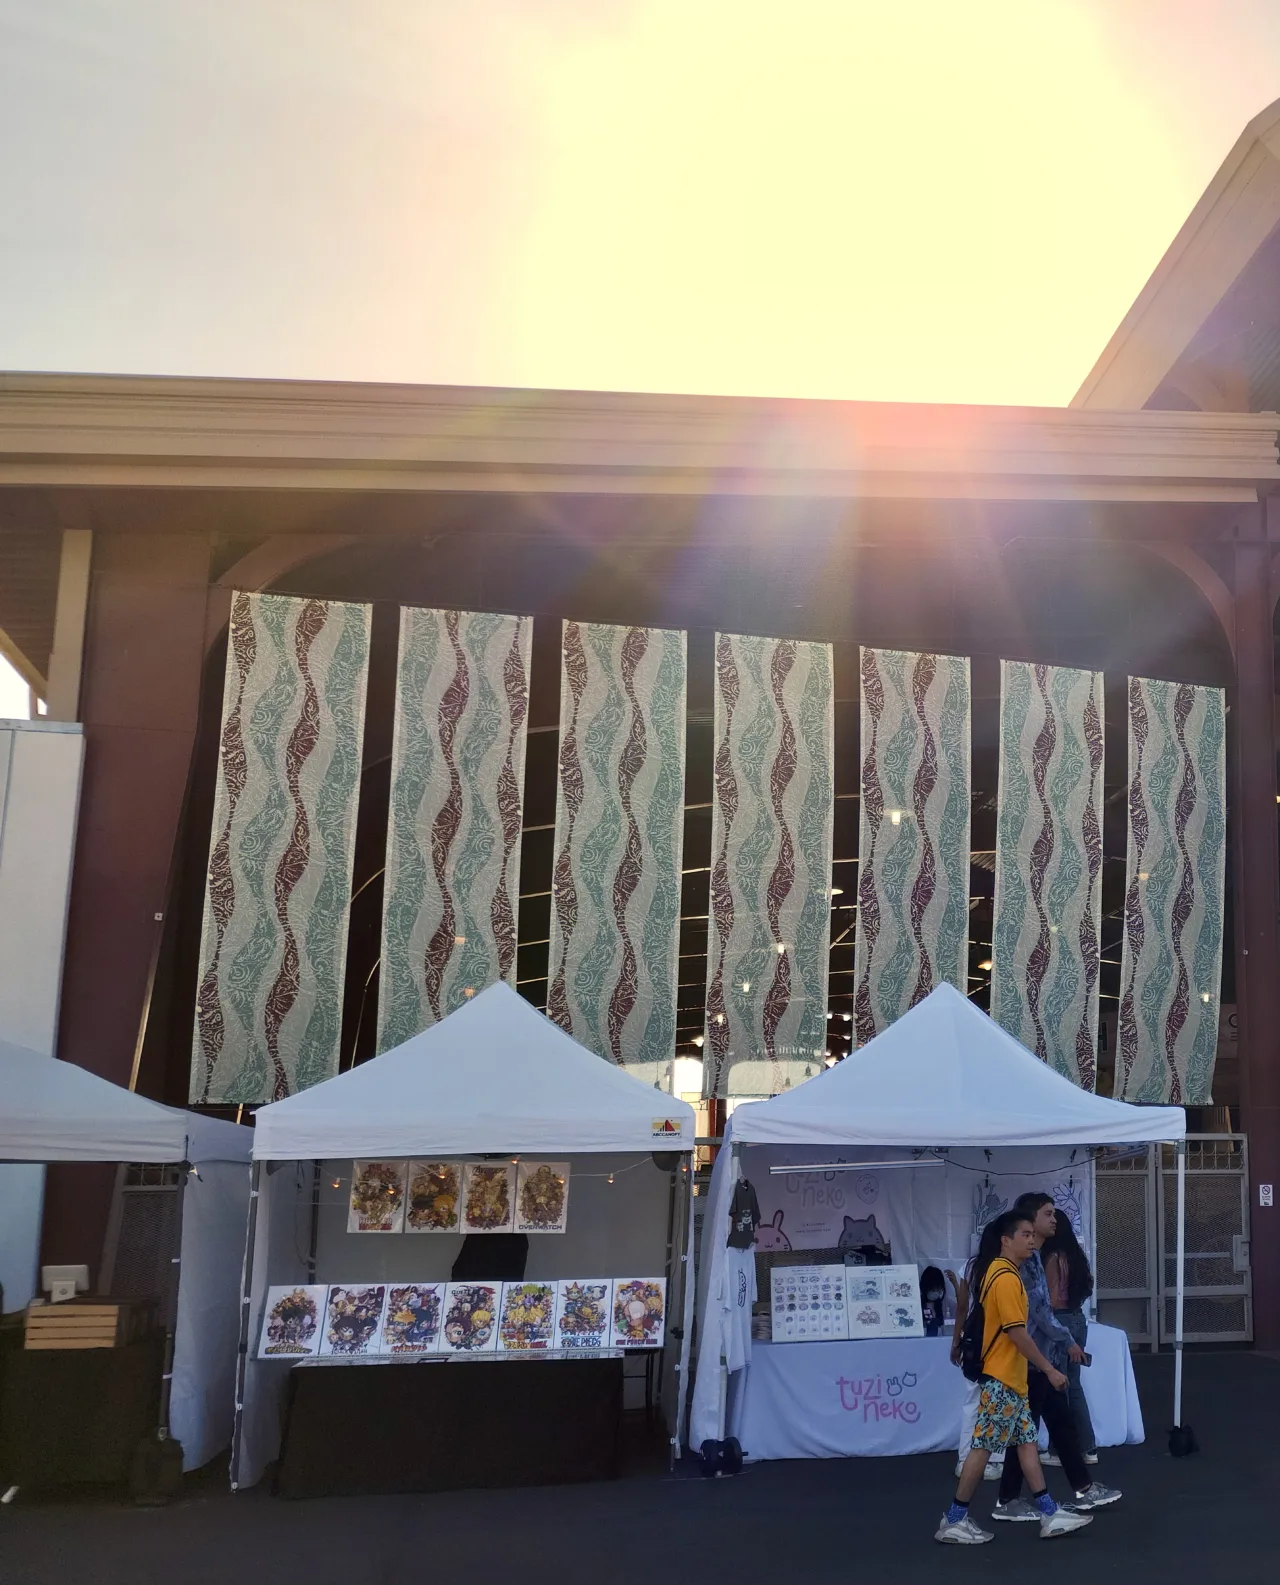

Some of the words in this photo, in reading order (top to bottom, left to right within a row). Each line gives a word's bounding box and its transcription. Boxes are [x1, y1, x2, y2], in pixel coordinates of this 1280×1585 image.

[803, 1185, 845, 1209] neko
[835, 1373, 882, 1411] tuzi
[863, 1398, 921, 1424] neko
